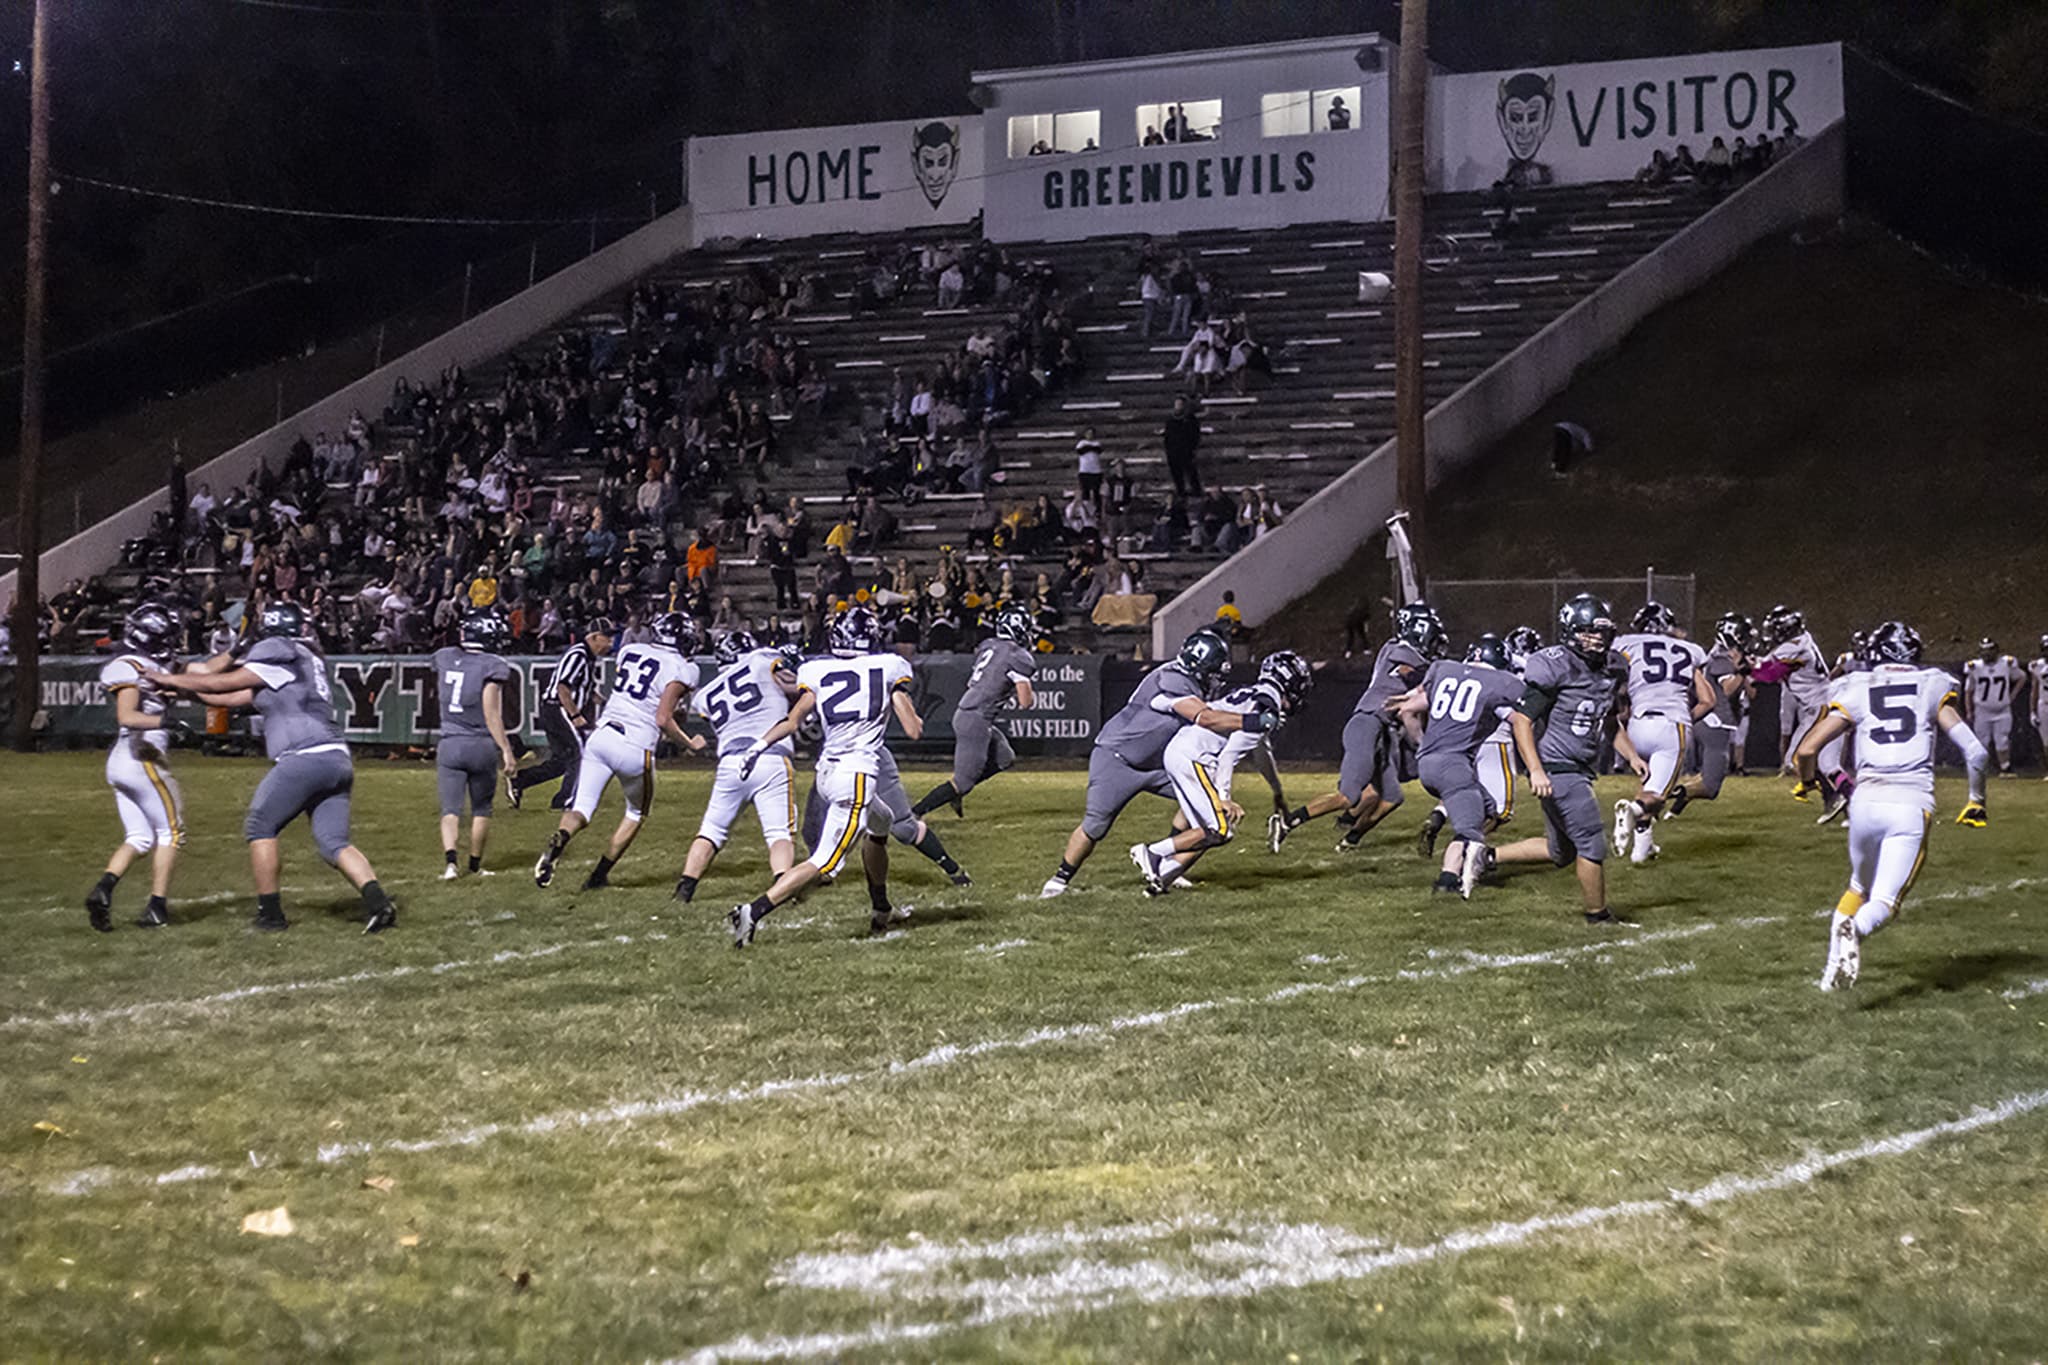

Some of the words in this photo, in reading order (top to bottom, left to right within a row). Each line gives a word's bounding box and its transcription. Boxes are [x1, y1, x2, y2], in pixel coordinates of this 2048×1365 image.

[1566, 68, 1799, 148] VISITOR
[748, 145, 882, 206] HOME
[1043, 151, 1316, 210] GREENDEVILS
[614, 652, 660, 701] 53
[1042, 667, 1057, 682] to
[1060, 665, 1085, 682] the
[1642, 641, 1694, 687] 52
[41, 680, 107, 706] HOME
[444, 670, 465, 713] 7
[706, 665, 764, 730] 55
[820, 668, 884, 726] 21
[1430, 677, 1482, 722] 60
[1977, 676, 2007, 701] 77
[1044, 719, 1090, 738] FIELD
[1868, 683, 1918, 745] 5
